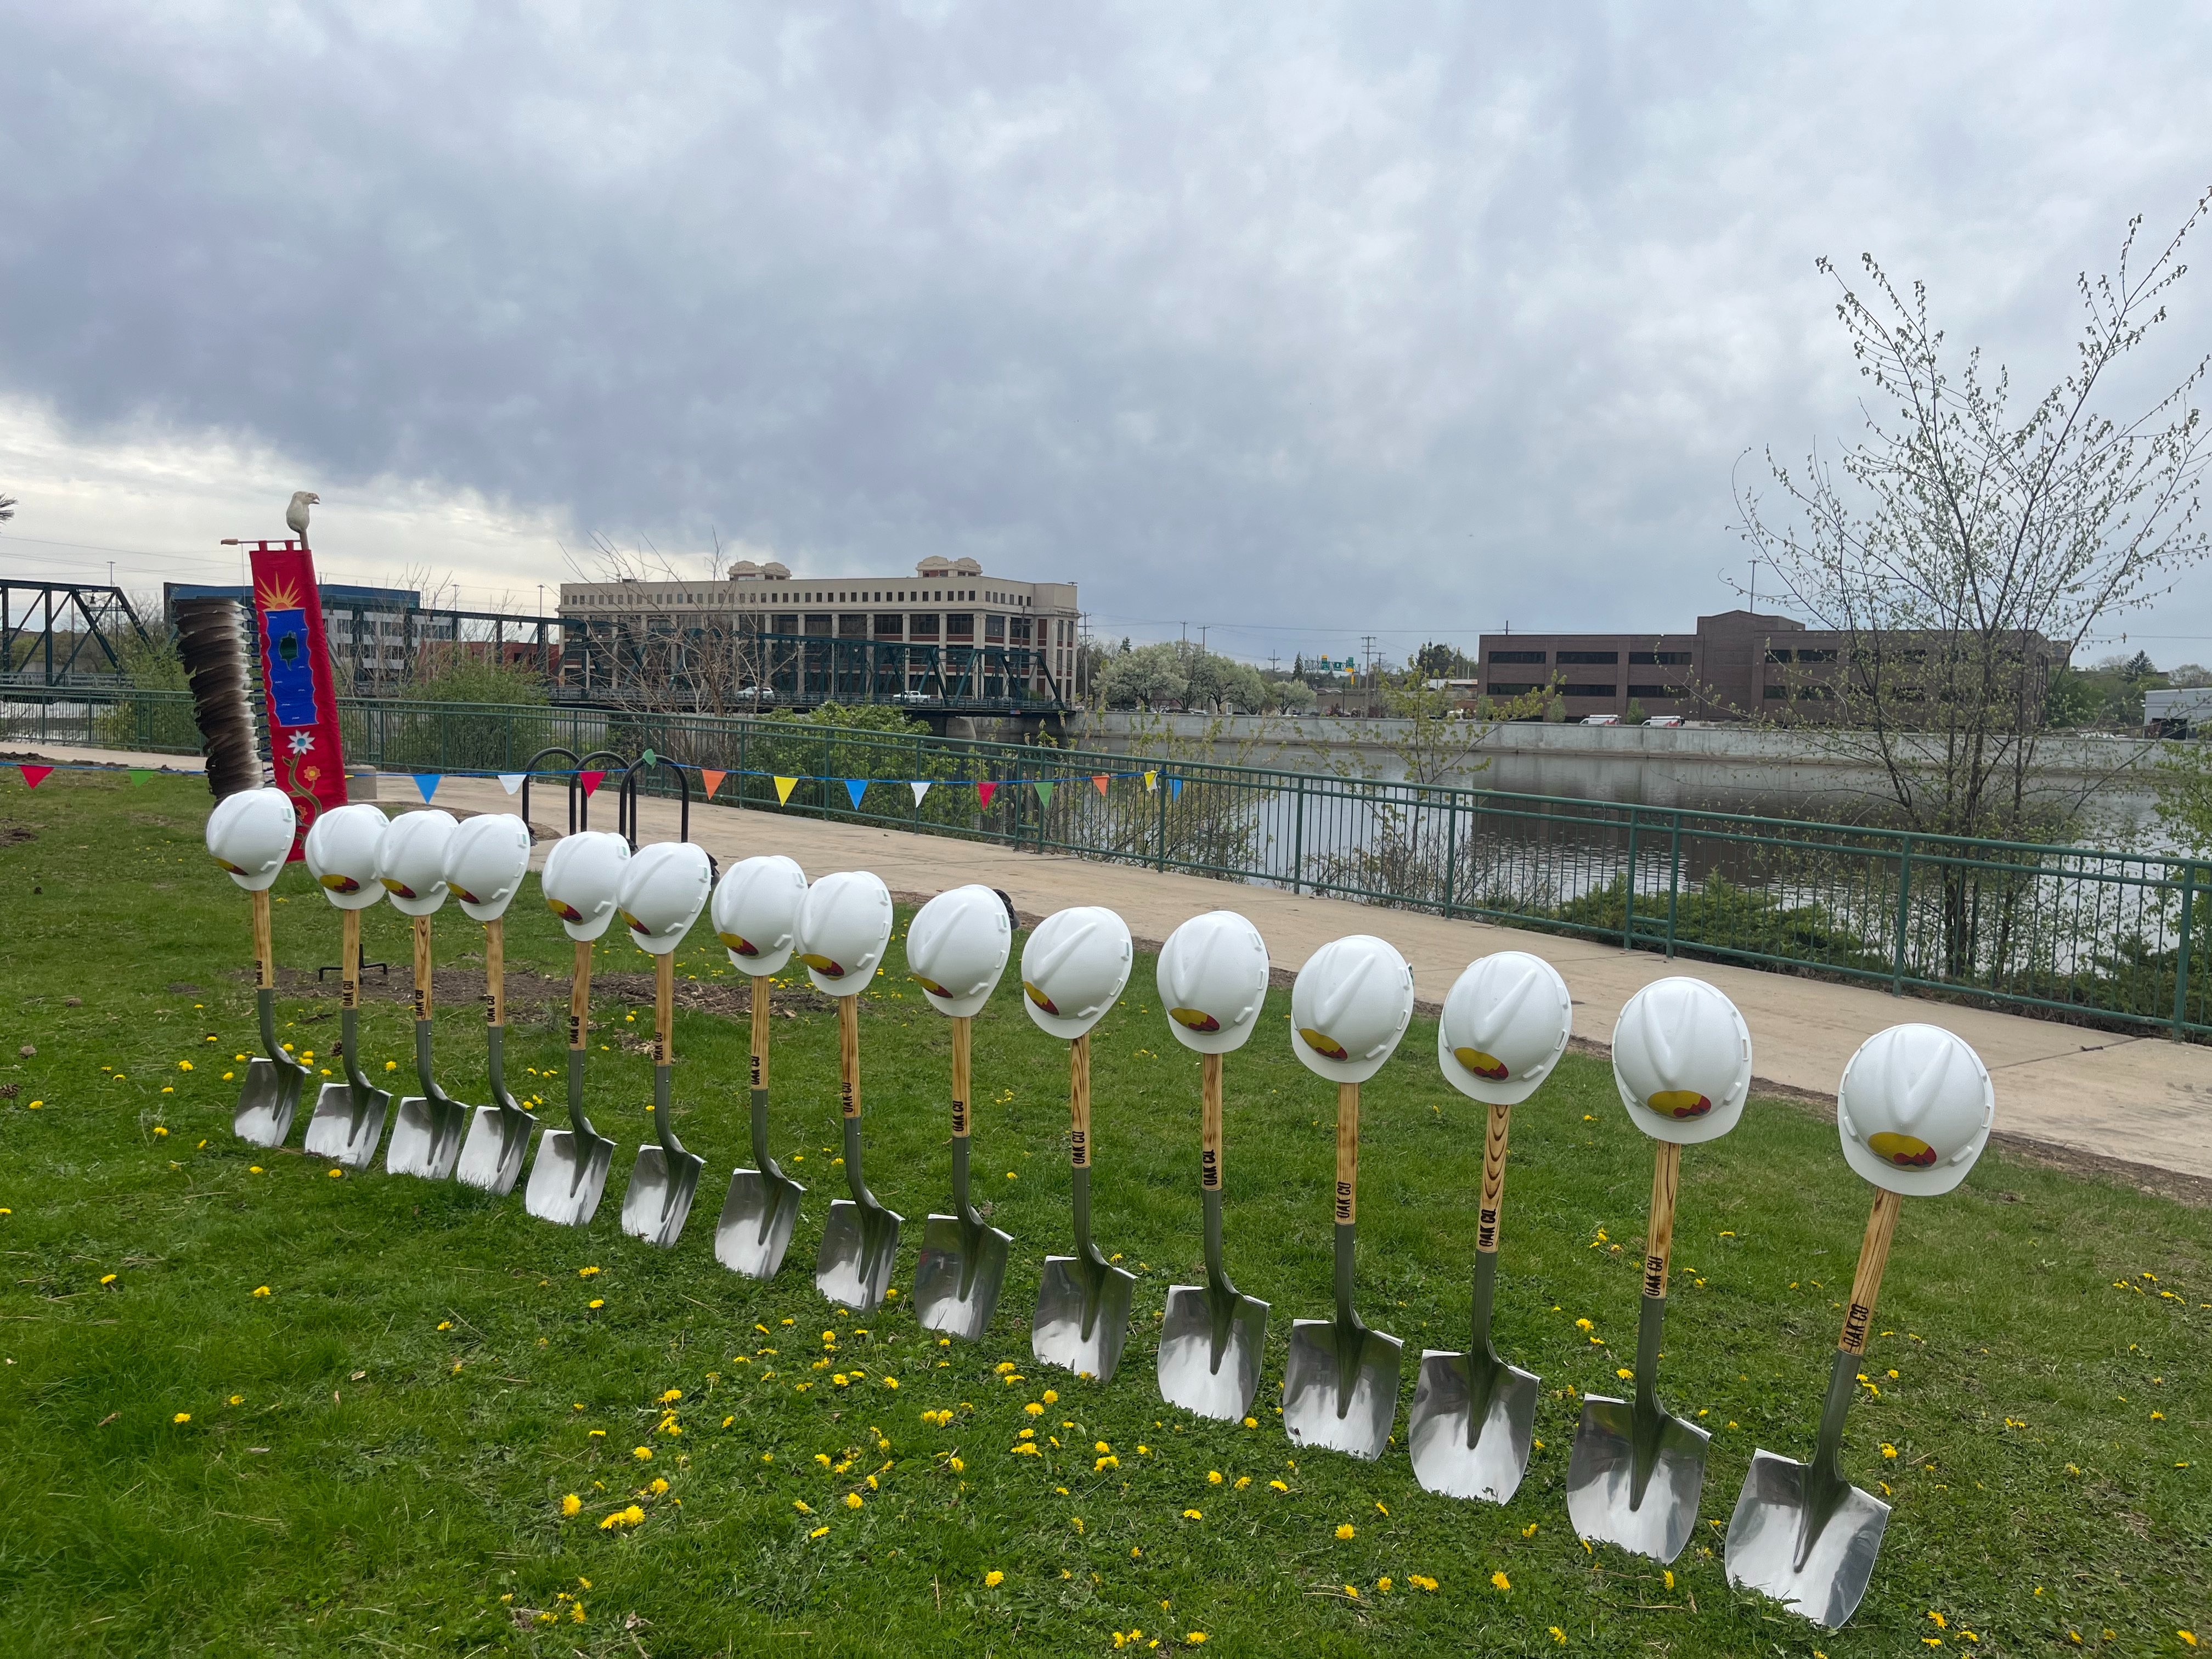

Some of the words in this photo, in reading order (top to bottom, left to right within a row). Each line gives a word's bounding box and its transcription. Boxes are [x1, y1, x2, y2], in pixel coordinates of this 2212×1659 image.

[843, 1096, 854, 1113] OAK
[952, 1114, 964, 1132] OAK
[1072, 1145, 1085, 1164] OAK
[1203, 1166, 1217, 1186] OAK
[1336, 1197, 1351, 1218] OAK
[1479, 1224, 1496, 1247] OAK
[1645, 1273, 1662, 1296] OAK
[1843, 1319, 1865, 1347] OAK
